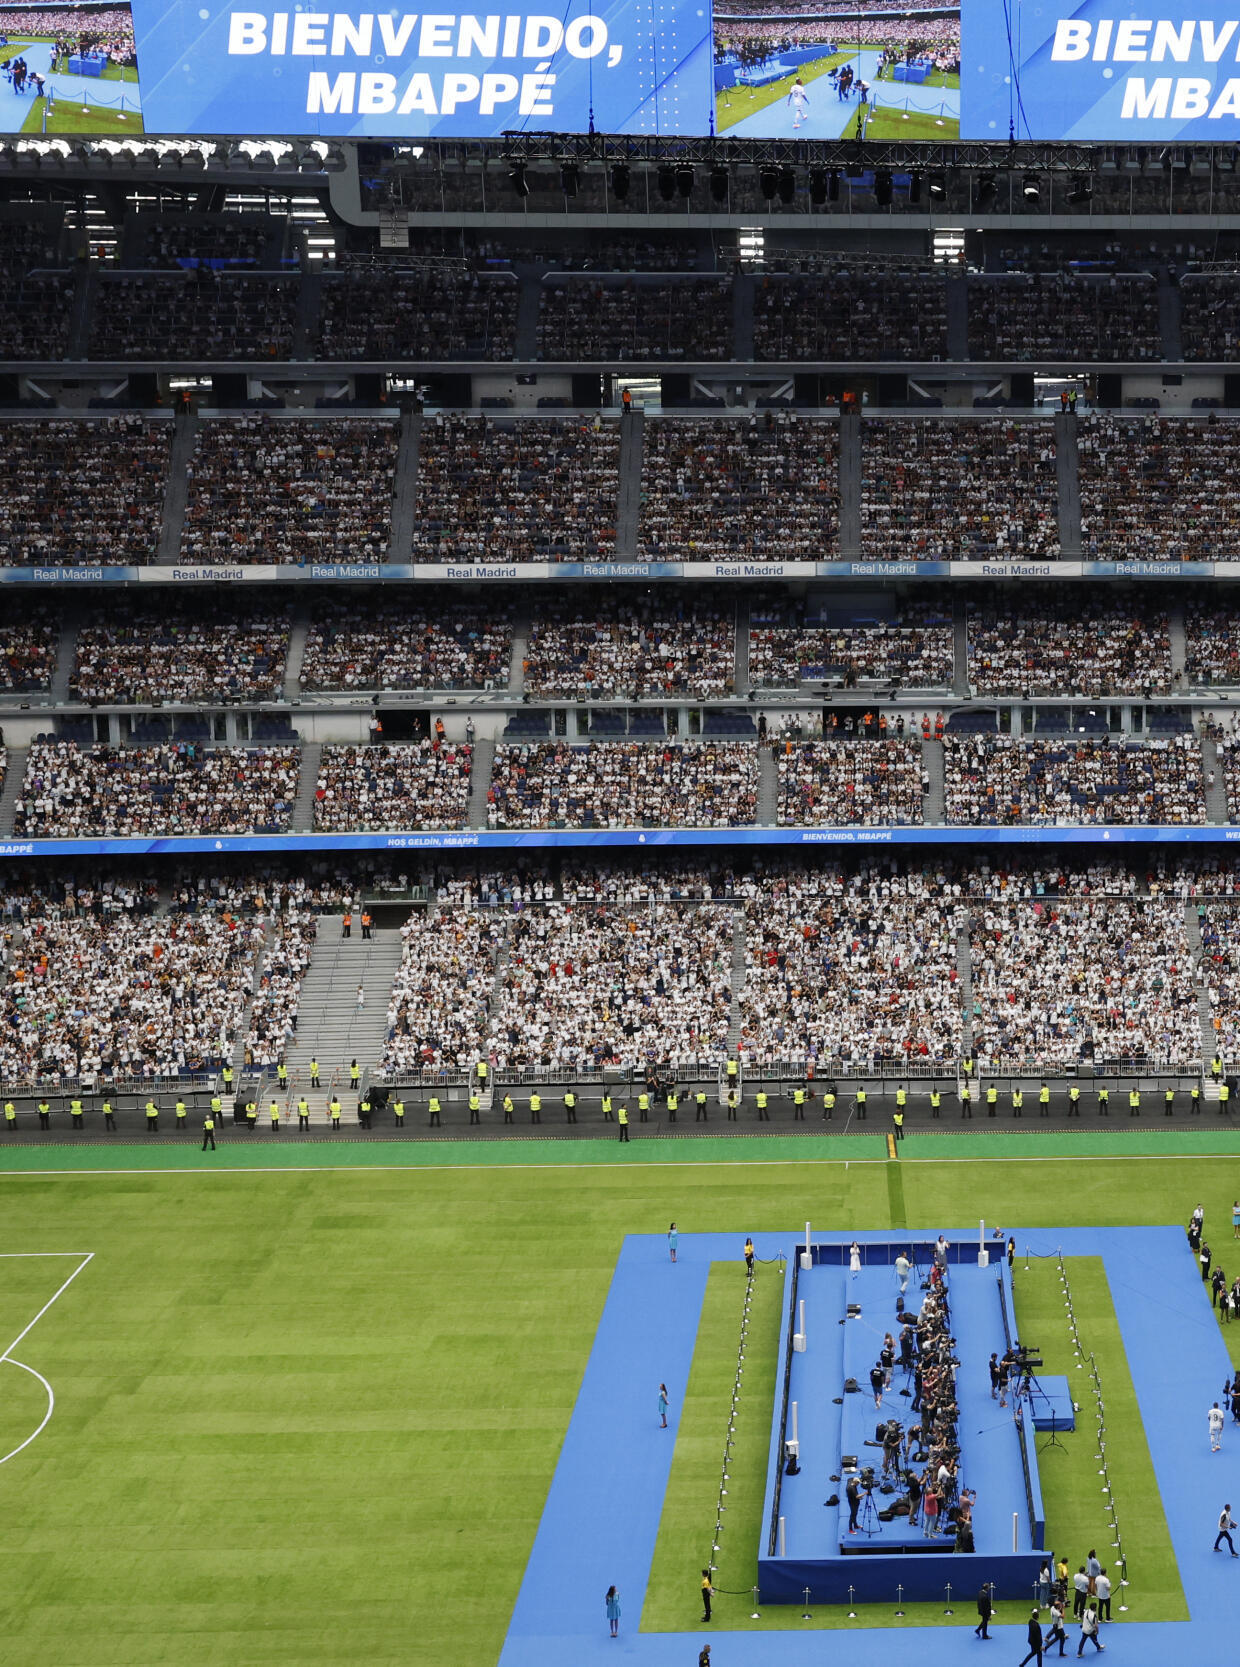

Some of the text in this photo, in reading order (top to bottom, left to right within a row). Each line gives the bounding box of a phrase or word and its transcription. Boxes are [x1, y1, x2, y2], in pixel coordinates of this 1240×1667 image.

[228, 12, 623, 68] BIENVENIDO,
[305, 62, 556, 116] MBAPPÉ
[312, 566, 379, 577] Real Madrid
[447, 568, 516, 578] Real Madrid
[583, 565, 649, 576] Real Madrid
[716, 566, 784, 576] Real Madrid
[851, 563, 916, 574] Real Madrid
[982, 566, 1050, 576] Real Madrid
[1116, 564, 1180, 574] Real Madrid
[33, 569, 102, 580] Real Madrid
[173, 569, 243, 580] Real Madrid
[802, 832, 892, 840] BIENVENIDO, MBAPPÉ
